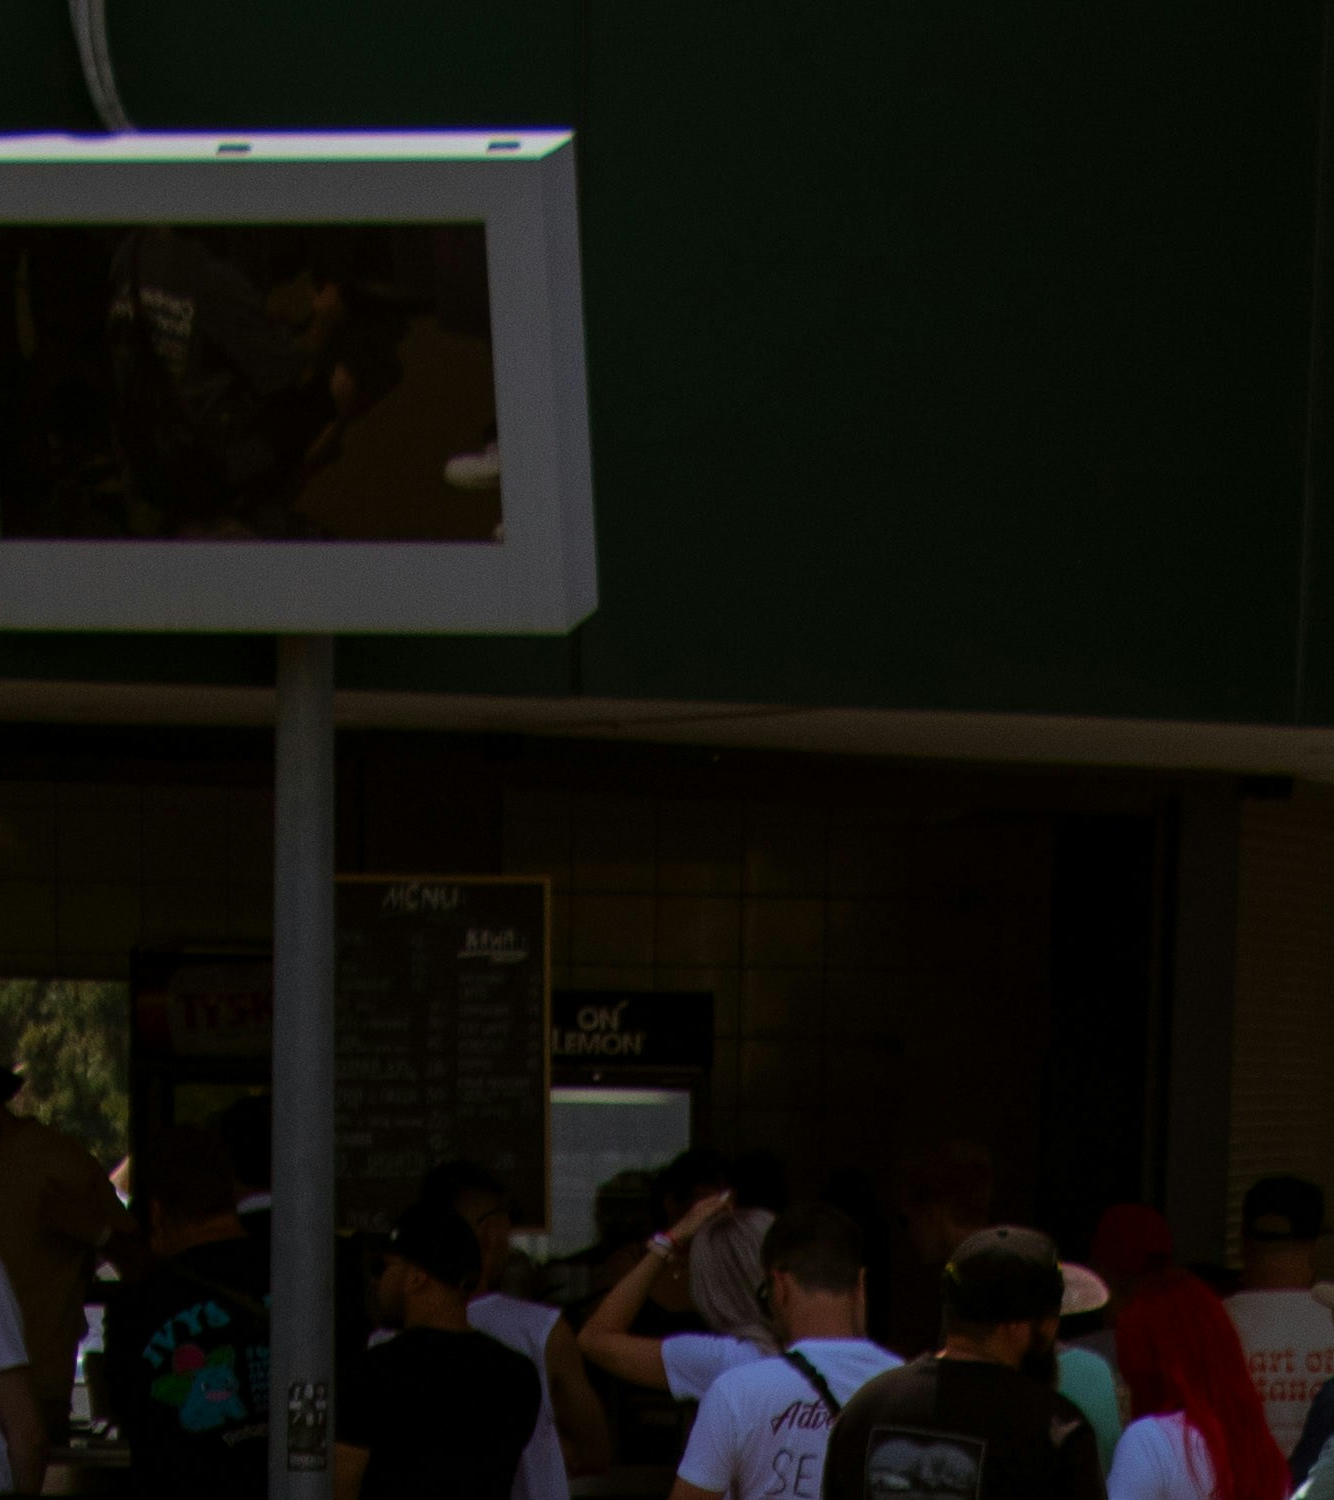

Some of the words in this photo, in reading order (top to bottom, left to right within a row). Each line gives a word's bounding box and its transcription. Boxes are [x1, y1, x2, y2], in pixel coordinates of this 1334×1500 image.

[381, 882, 460, 912] MENU
[576, 1002, 622, 1033] ON
[553, 1027, 644, 1057] LEMON
[766, 1448, 817, 1500] SE
